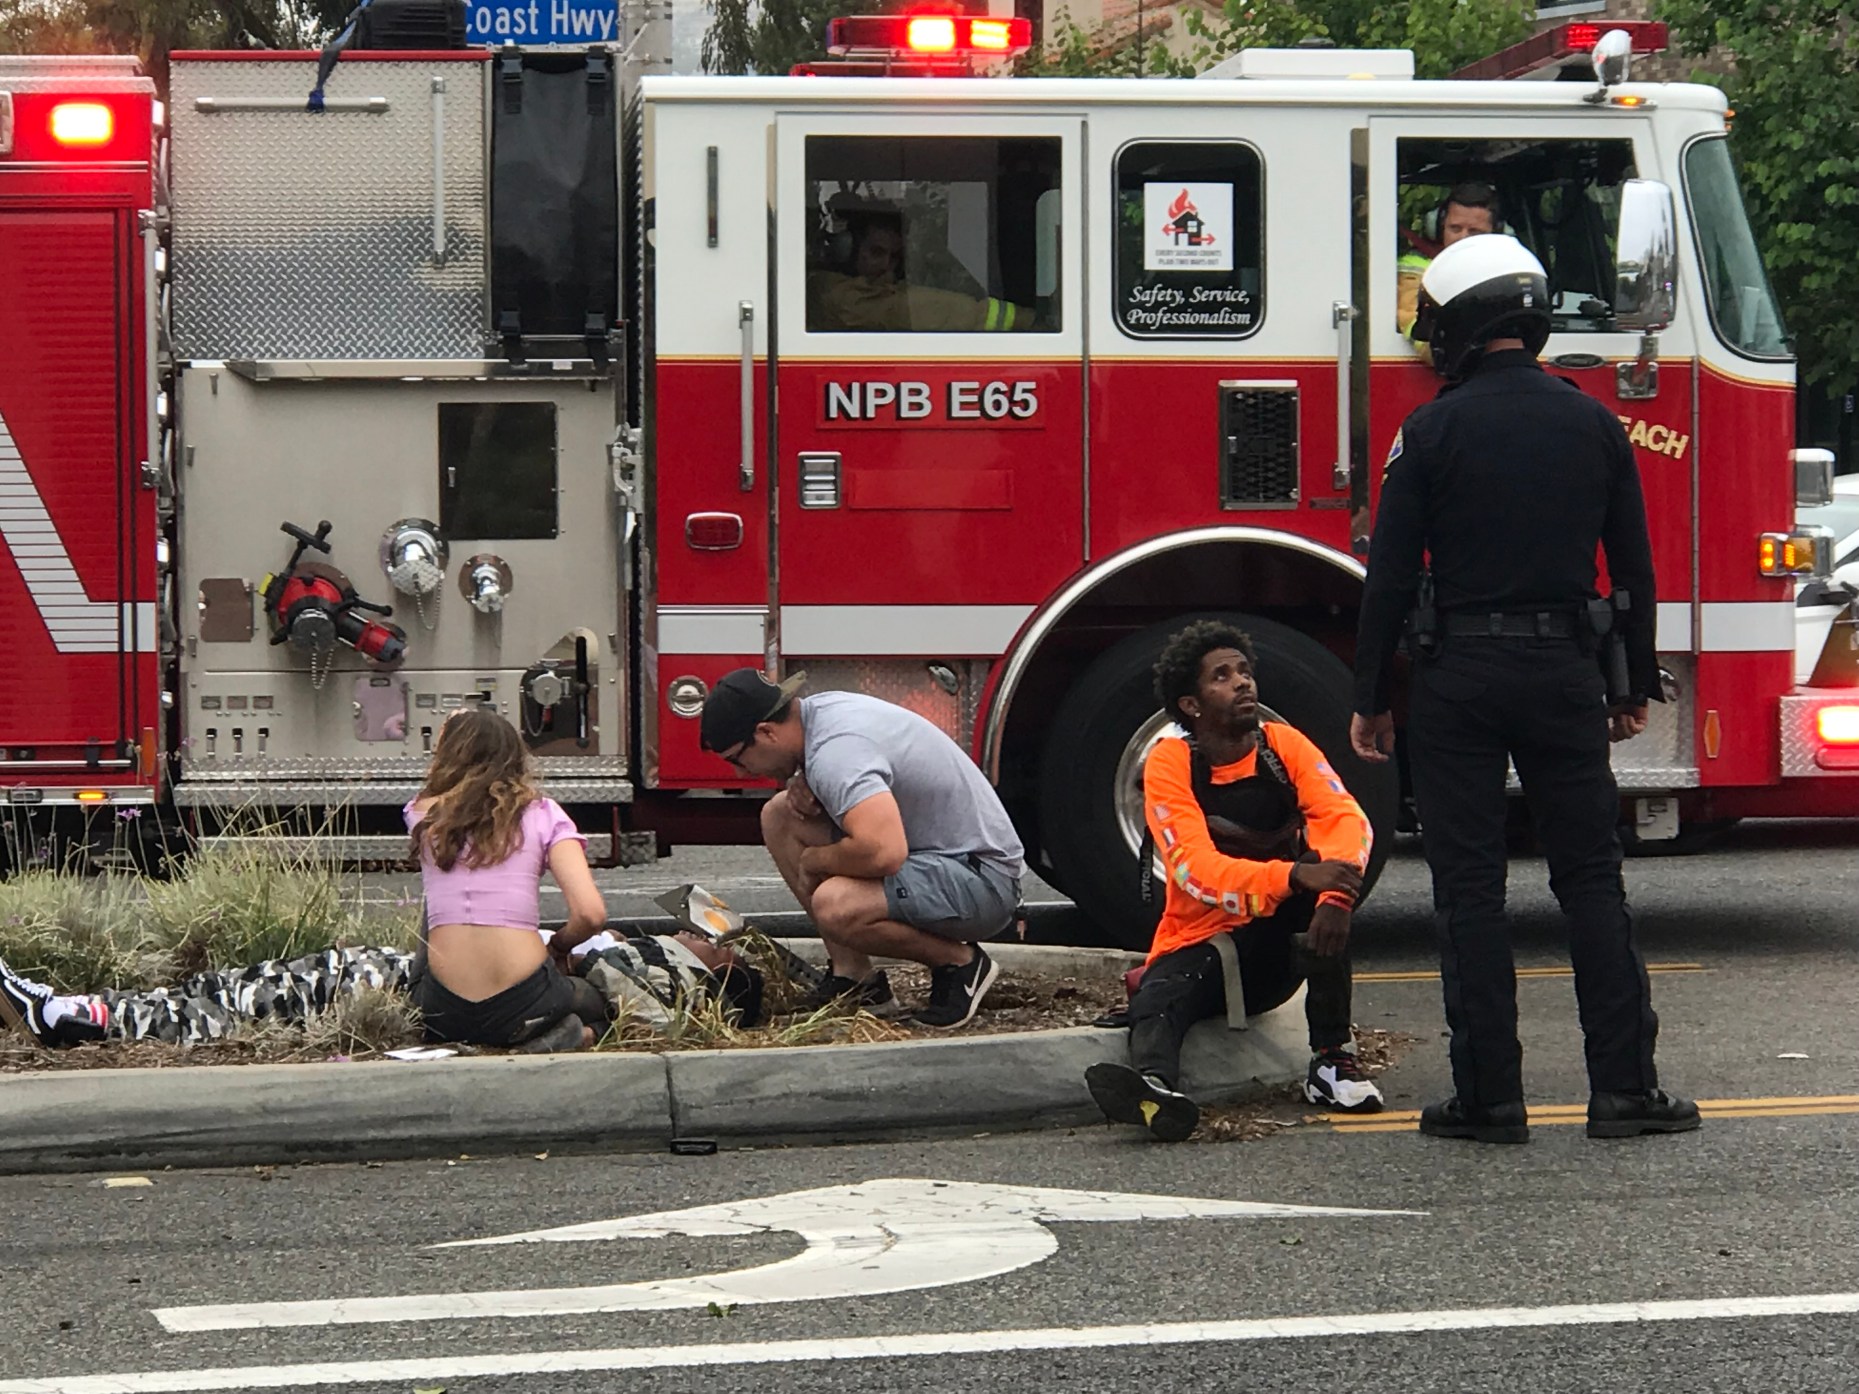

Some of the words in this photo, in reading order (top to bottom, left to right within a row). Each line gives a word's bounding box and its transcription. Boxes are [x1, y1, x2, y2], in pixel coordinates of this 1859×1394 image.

[551, 0, 615, 40] Hwy
[1128, 283, 1185, 306] Safety,
[1188, 286, 1250, 305] Service,
[1126, 306, 1251, 330] Professionalism
[826, 381, 933, 419] NPB
[949, 381, 1038, 419] E65
